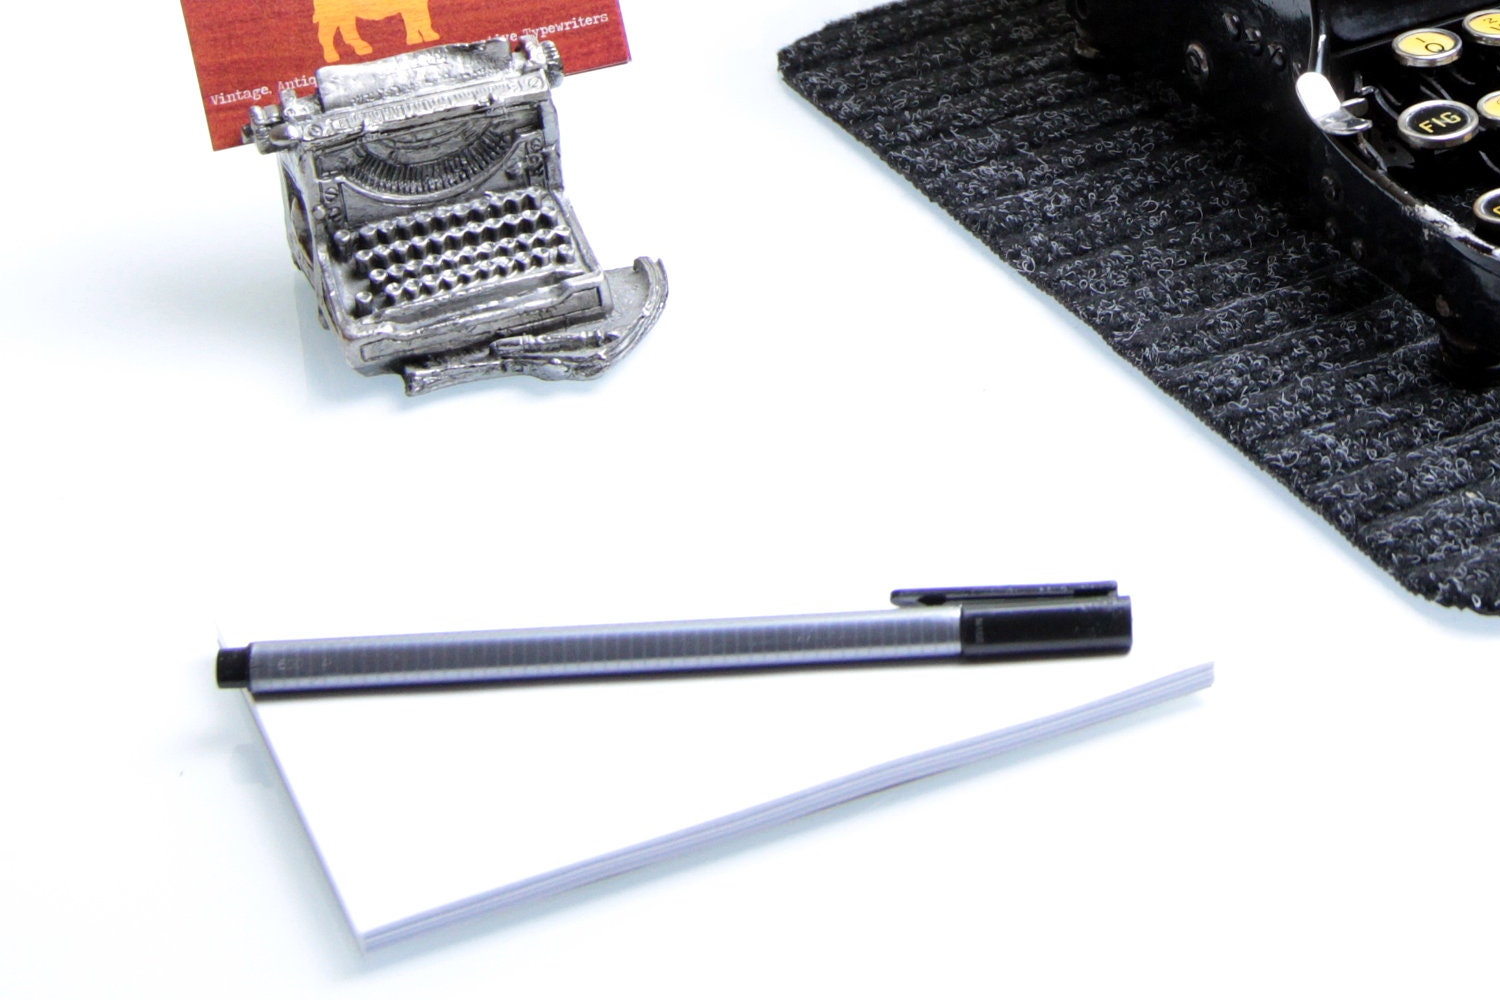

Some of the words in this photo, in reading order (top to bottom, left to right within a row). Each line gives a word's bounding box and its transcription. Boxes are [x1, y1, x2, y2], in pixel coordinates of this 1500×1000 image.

[210, 85, 273, 106] Vintage,
[278, 75, 318, 91] Antiq
[522, 13, 609, 39] Typewriters
[1418, 111, 1461, 133] FIG
